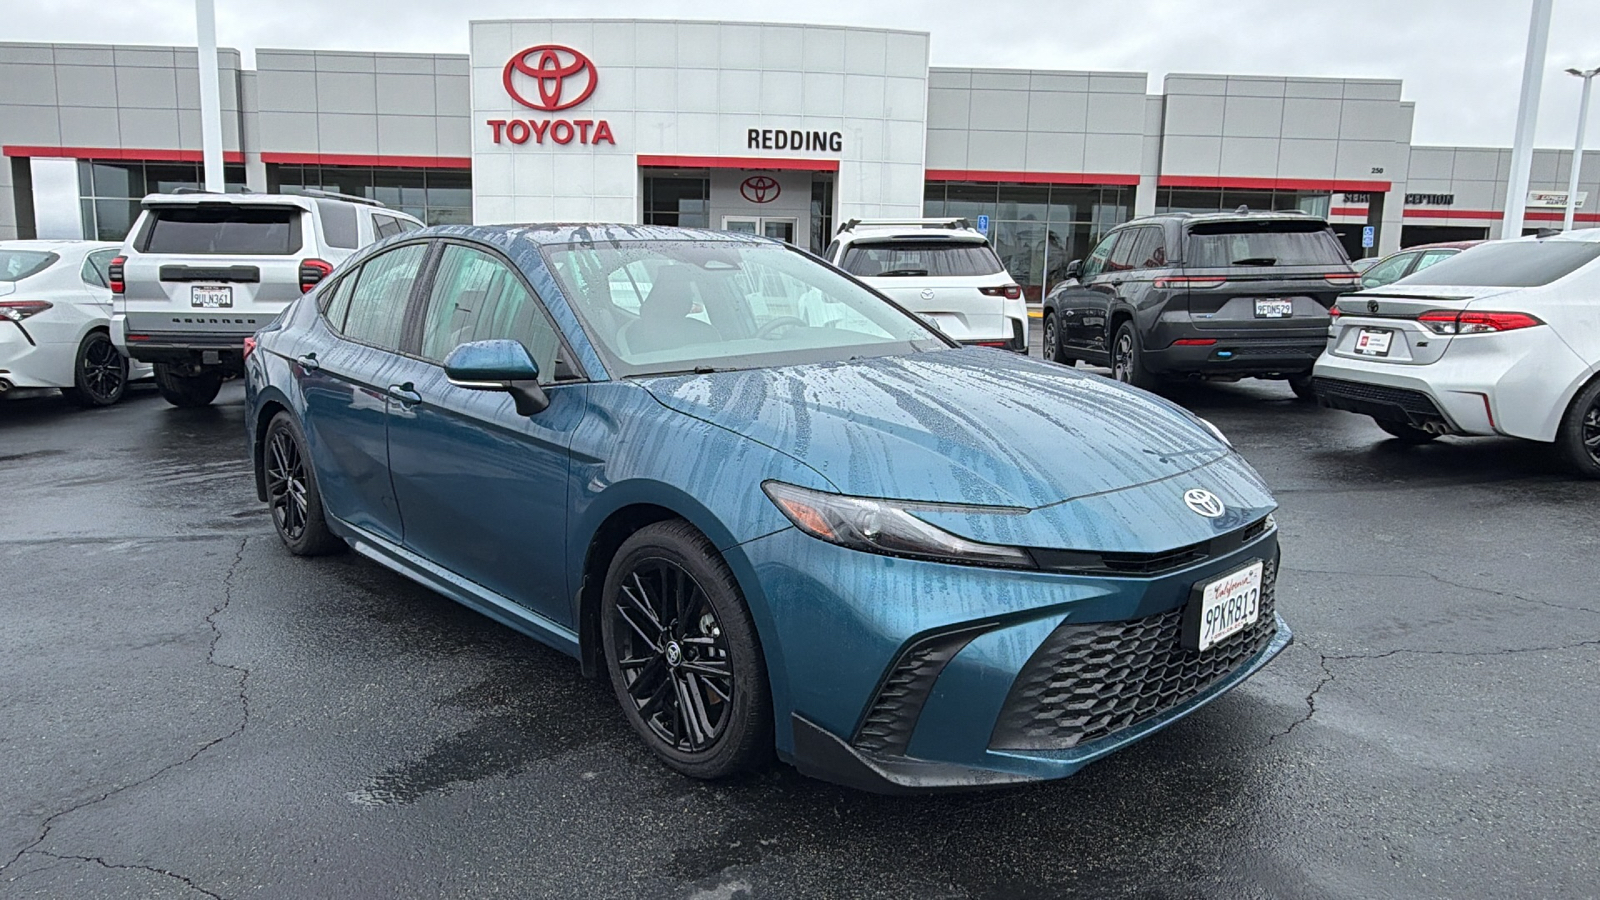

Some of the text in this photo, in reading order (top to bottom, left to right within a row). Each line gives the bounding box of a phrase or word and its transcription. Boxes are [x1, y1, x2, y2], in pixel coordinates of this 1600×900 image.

[487, 119, 615, 145] TOYOTA
[747, 128, 842, 152] REDDING
[1405, 193, 1454, 205] CEPTION
[193, 293, 228, 304] 9ULN361
[1214, 577, 1251, 599] California
[1204, 587, 1257, 639] 9PKR813
